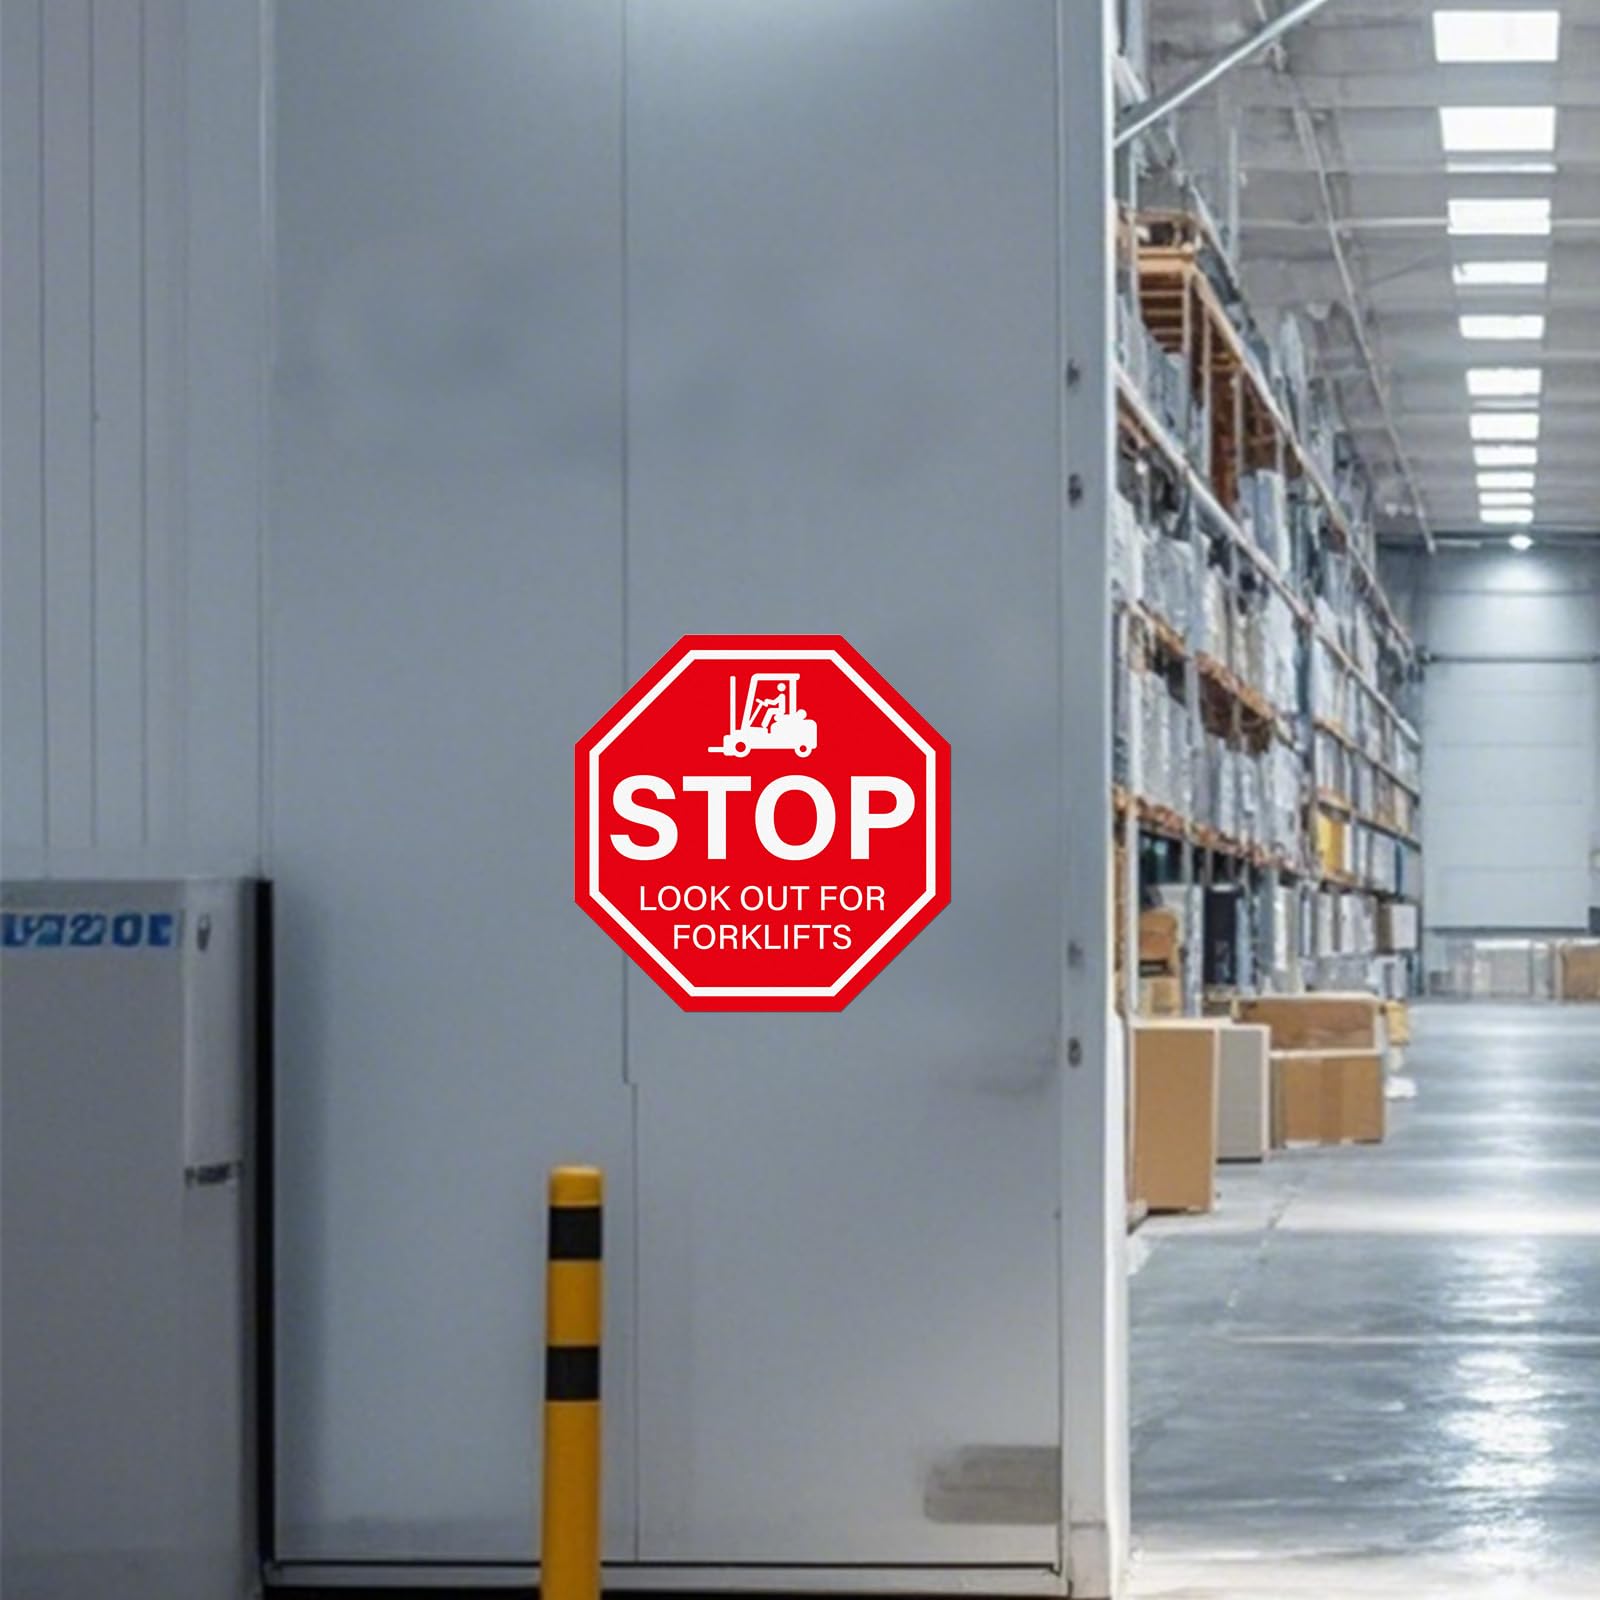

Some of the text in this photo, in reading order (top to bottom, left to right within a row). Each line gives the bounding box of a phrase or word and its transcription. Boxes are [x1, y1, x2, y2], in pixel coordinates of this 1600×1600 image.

[610, 775, 915, 860] STOP
[641, 886, 884, 911] LOOK OUT FOR
[674, 924, 851, 949] FORKLIFTS
